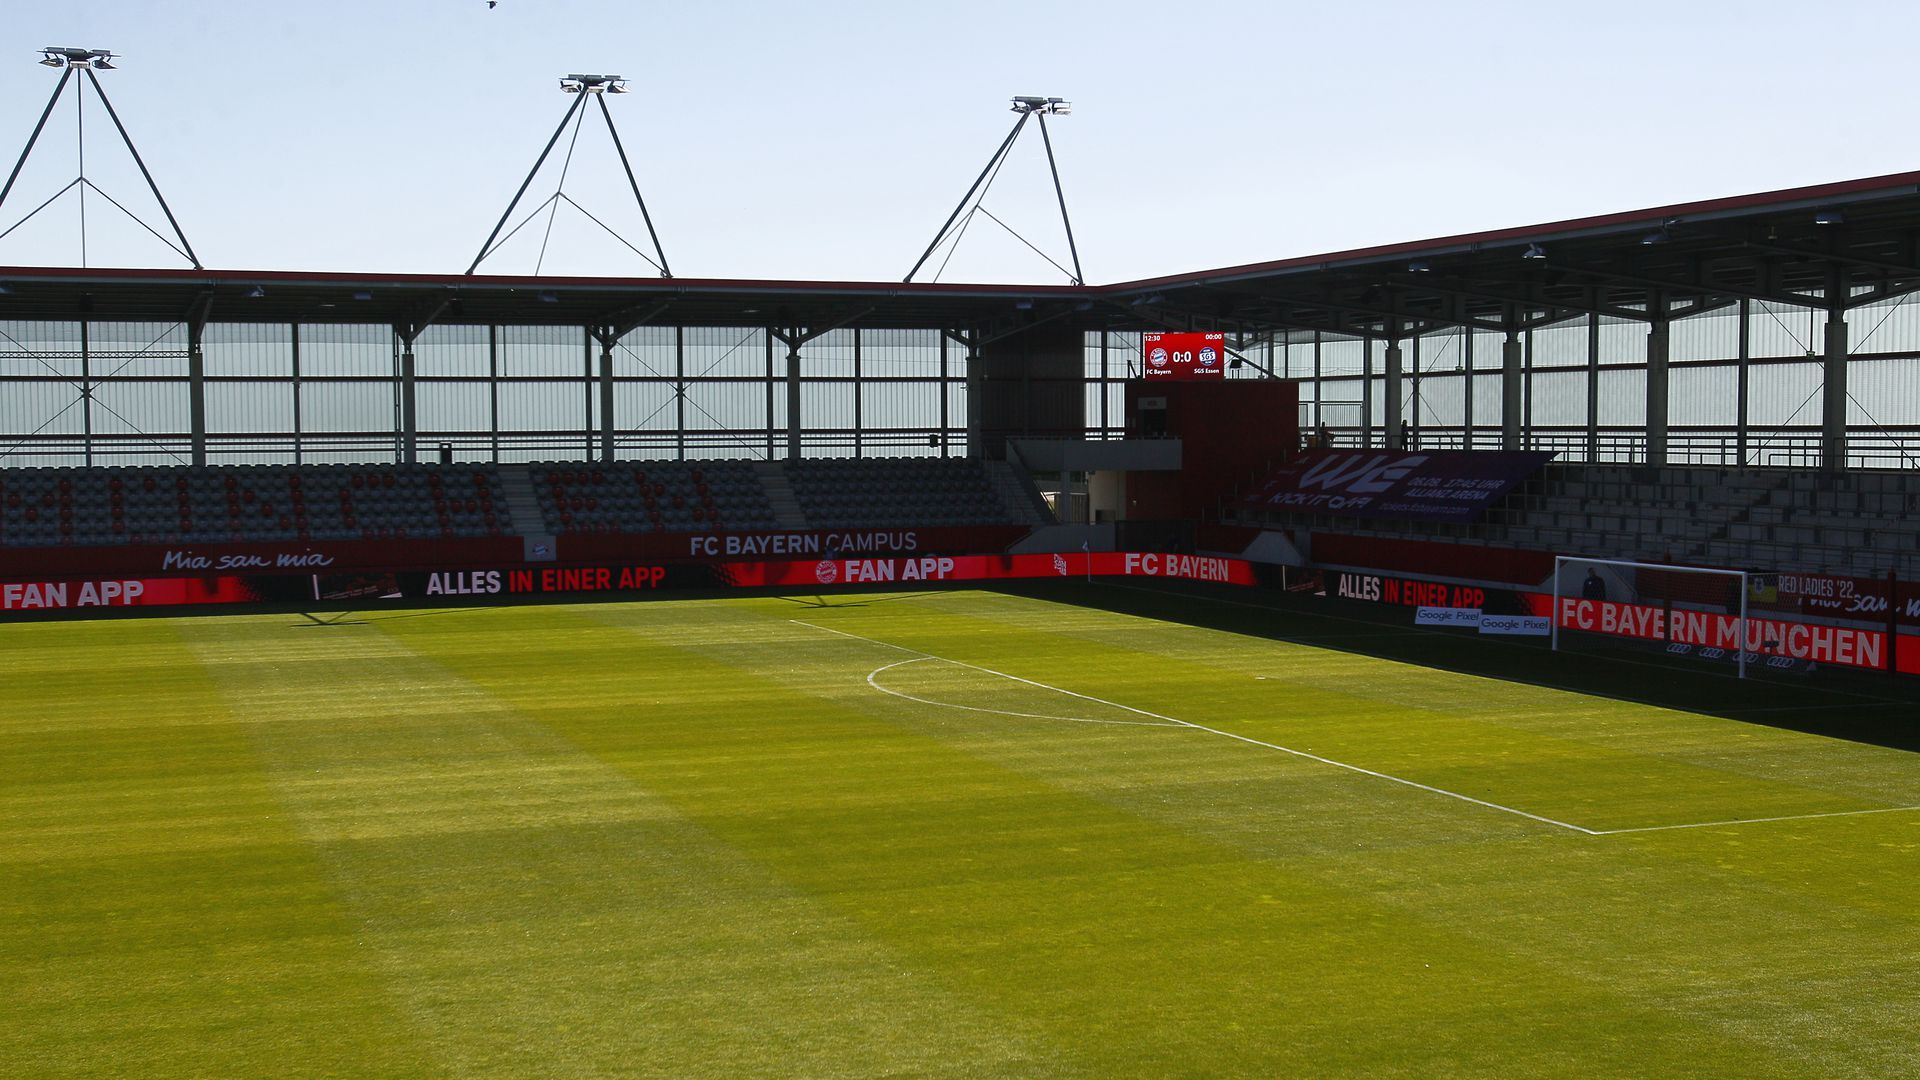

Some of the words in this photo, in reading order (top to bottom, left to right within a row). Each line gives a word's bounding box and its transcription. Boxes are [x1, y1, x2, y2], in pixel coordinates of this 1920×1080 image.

[1172, 351, 1192, 363] 0:0
[1201, 352, 1214, 361] SGS
[1404, 488, 1454, 498] ALLIANZ
[1448, 490, 1490, 500] ARENA
[690, 536, 719, 557] FC
[725, 534, 820, 555] BAYERN
[825, 531, 917, 552] CAMPUS
[162, 550, 212, 570] Mia
[213, 554, 271, 570] san
[276, 547, 336, 568] mia
[845, 558, 896, 583] FAN
[902, 557, 955, 581] APP
[1125, 552, 1159, 576] FC
[1166, 553, 1230, 582] BAYERN
[426, 571, 502, 597] ALLES
[508, 569, 534, 593] IN
[541, 567, 612, 592] EINER
[618, 566, 667, 590] APP
[1338, 573, 1381, 603] ALLES
[1384, 578, 1400, 605] IN
[1403, 580, 1448, 608] EINER
[1452, 586, 1486, 608] APP
[1778, 575, 1797, 594] RED
[1799, 576, 1834, 597] LADIES
[1836, 579, 1855, 599] '22
[4, 583, 68, 610] FAN
[77, 581, 145, 607] APP
[1418, 609, 1453, 621] Google
[1456, 611, 1480, 621] Pixel
[1481, 618, 1520, 631] Google
[1524, 620, 1549, 630] Pixel
[1562, 598, 1595, 630] FC
[1602, 602, 1708, 646] BAYERN
[1716, 614, 1880, 668] MÜNCHEN
